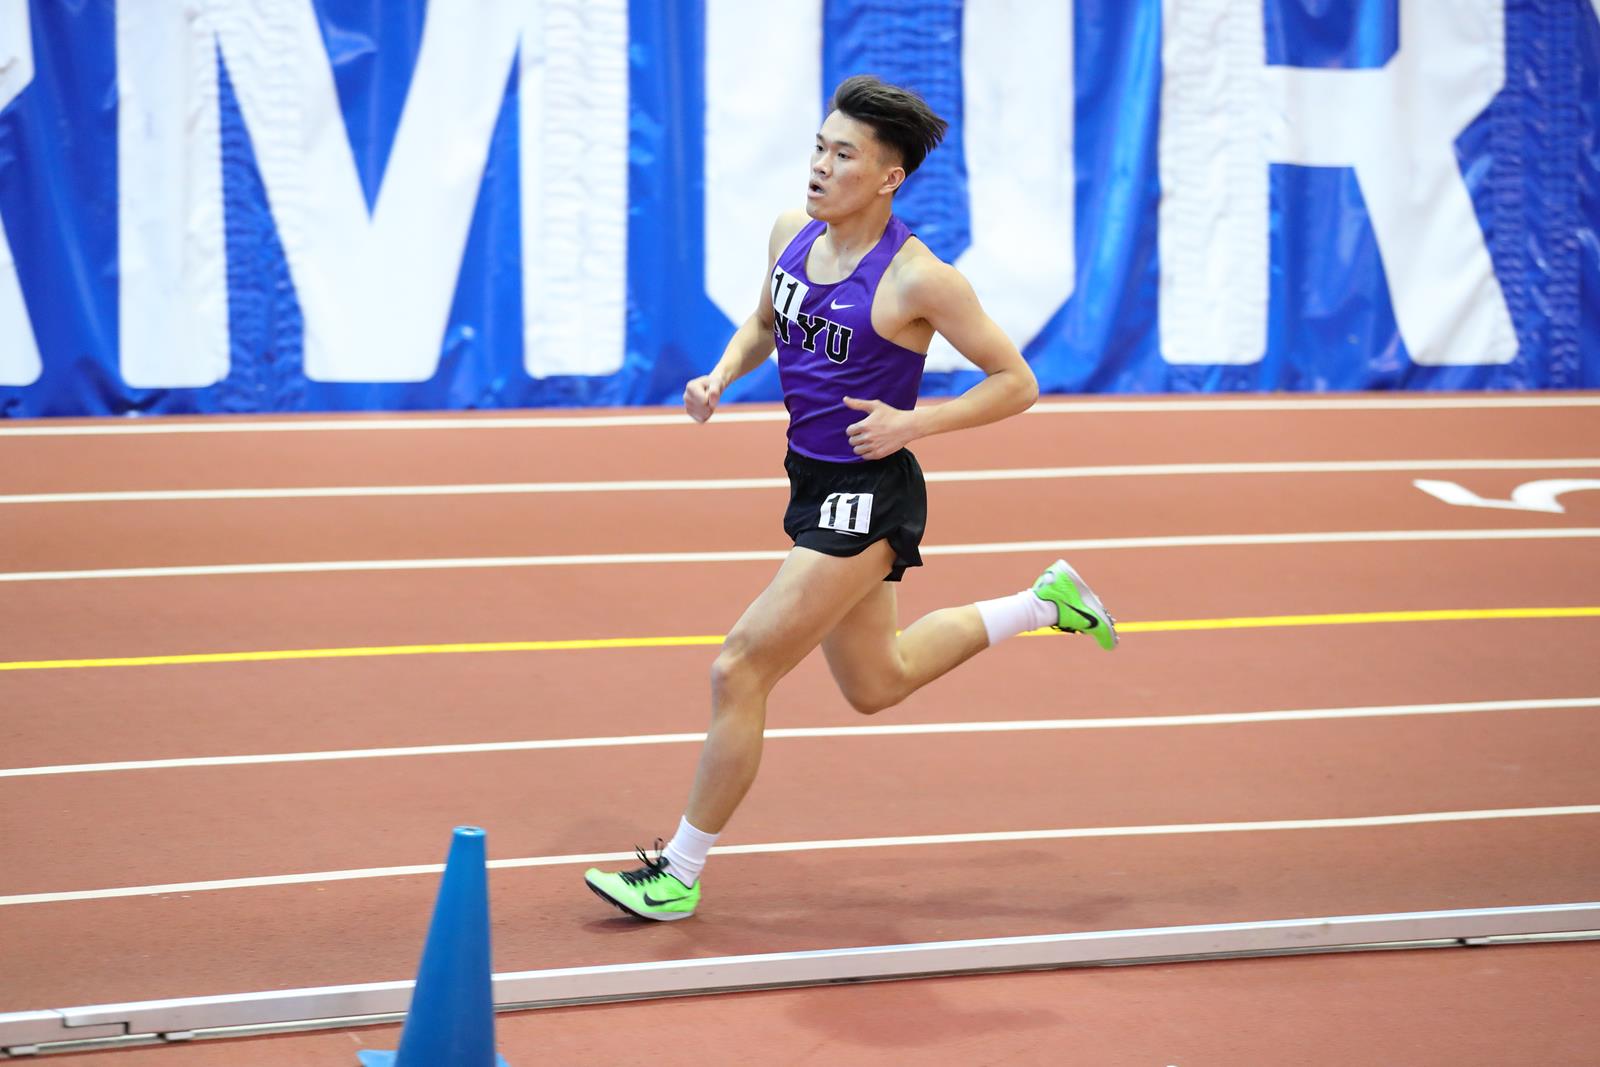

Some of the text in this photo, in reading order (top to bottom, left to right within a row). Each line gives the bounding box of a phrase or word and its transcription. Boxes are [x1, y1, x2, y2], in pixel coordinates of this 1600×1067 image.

[773, 271, 799, 315] 11
[774, 309, 854, 365] NYU
[827, 494, 861, 530] 11
